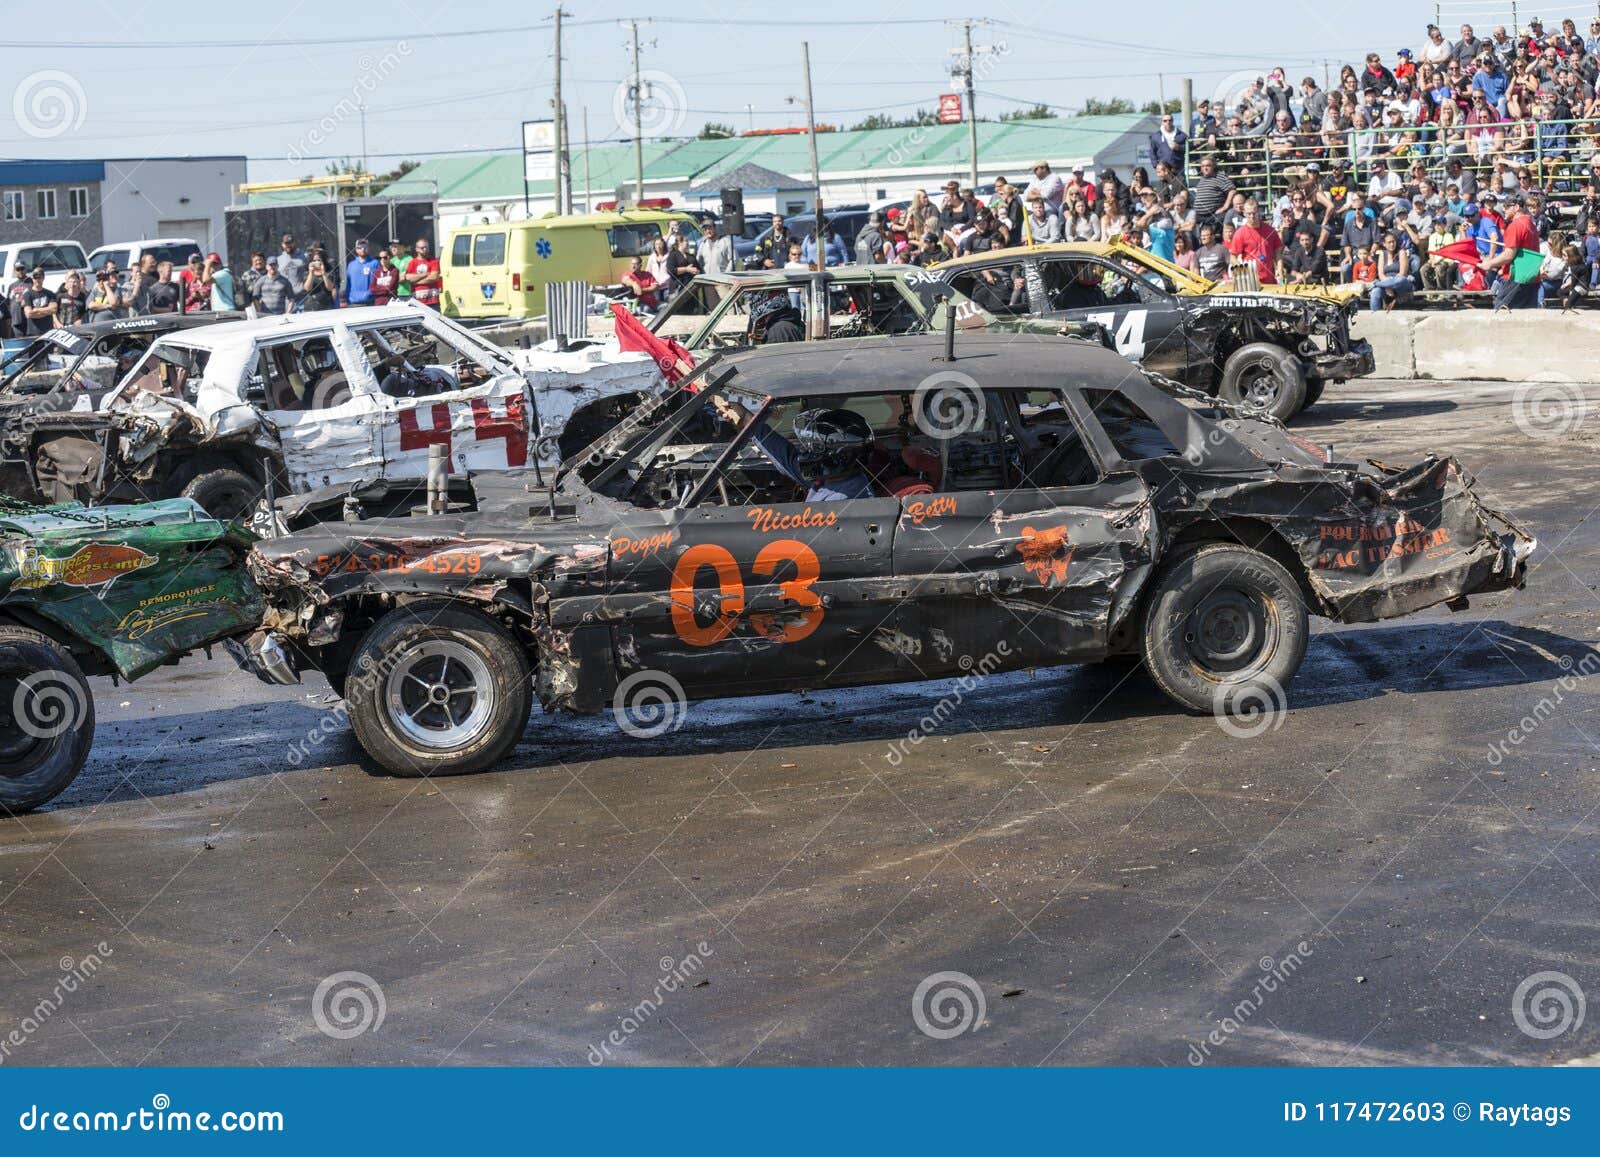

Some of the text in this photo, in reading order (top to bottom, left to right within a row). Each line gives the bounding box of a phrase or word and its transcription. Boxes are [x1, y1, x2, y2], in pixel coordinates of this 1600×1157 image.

[748, 507, 838, 532] Nicolas
[908, 495, 957, 524] Betty
[611, 531, 673, 560] Peggy
[139, 584, 216, 607] REMORQUAGE
[670, 539, 825, 647] 03
